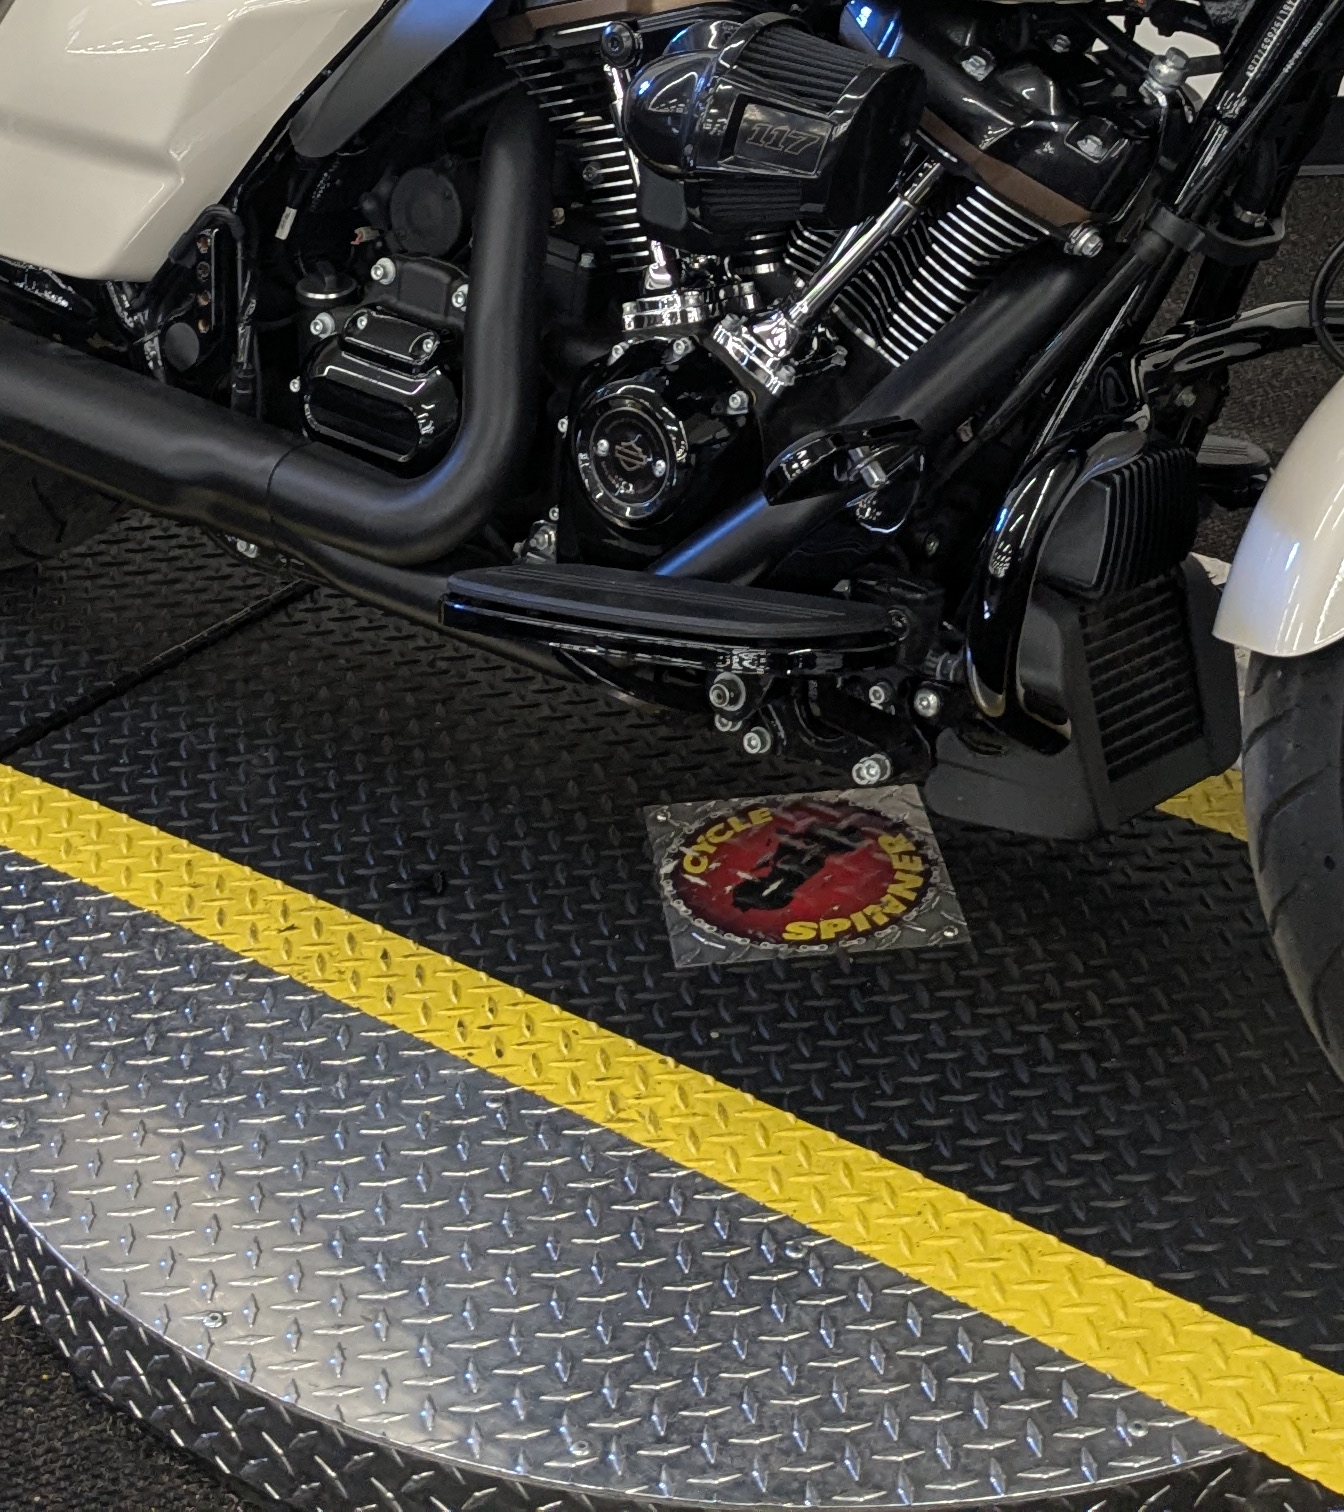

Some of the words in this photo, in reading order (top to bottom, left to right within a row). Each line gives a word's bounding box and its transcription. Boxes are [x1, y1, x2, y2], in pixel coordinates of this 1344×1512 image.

[746, 122, 821, 156] 117
[682, 806, 774, 875] CYCLE
[781, 832, 925, 942] SPINNER
